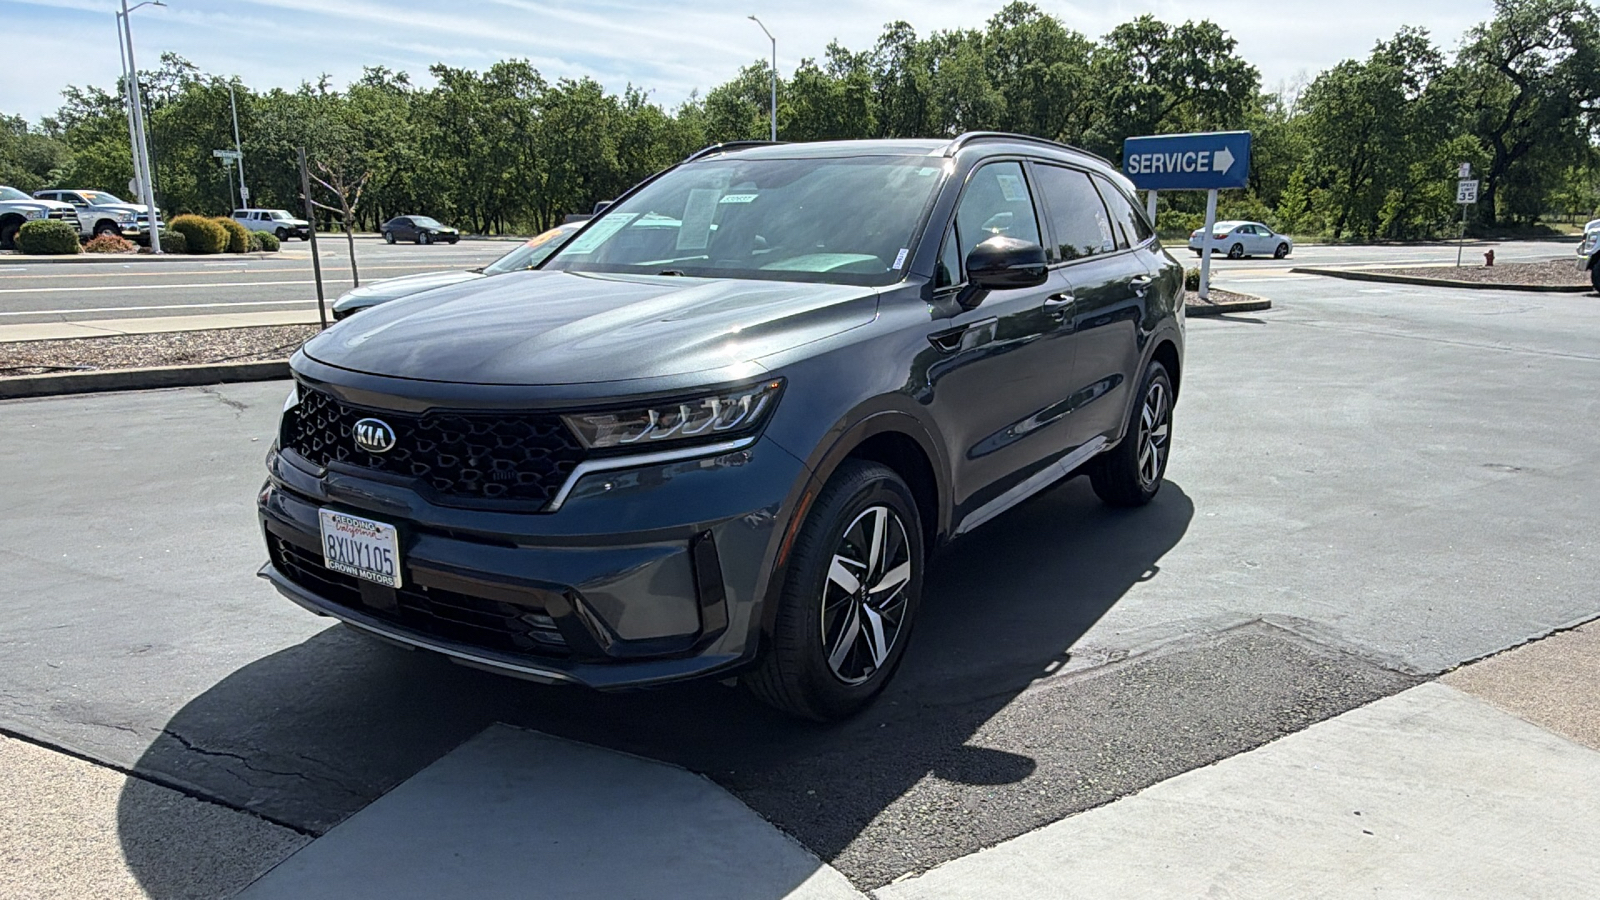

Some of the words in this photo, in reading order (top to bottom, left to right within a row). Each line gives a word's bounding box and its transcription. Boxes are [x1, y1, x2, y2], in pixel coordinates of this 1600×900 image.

[1128, 151, 1210, 174] SERVICE
[1459, 192, 1475, 201] 35
[357, 424, 387, 447] KIA
[335, 515, 376, 531] REDDING
[327, 534, 394, 576] 8XUY105
[329, 561, 358, 576] CROWN
[360, 569, 394, 586] MOTORS
